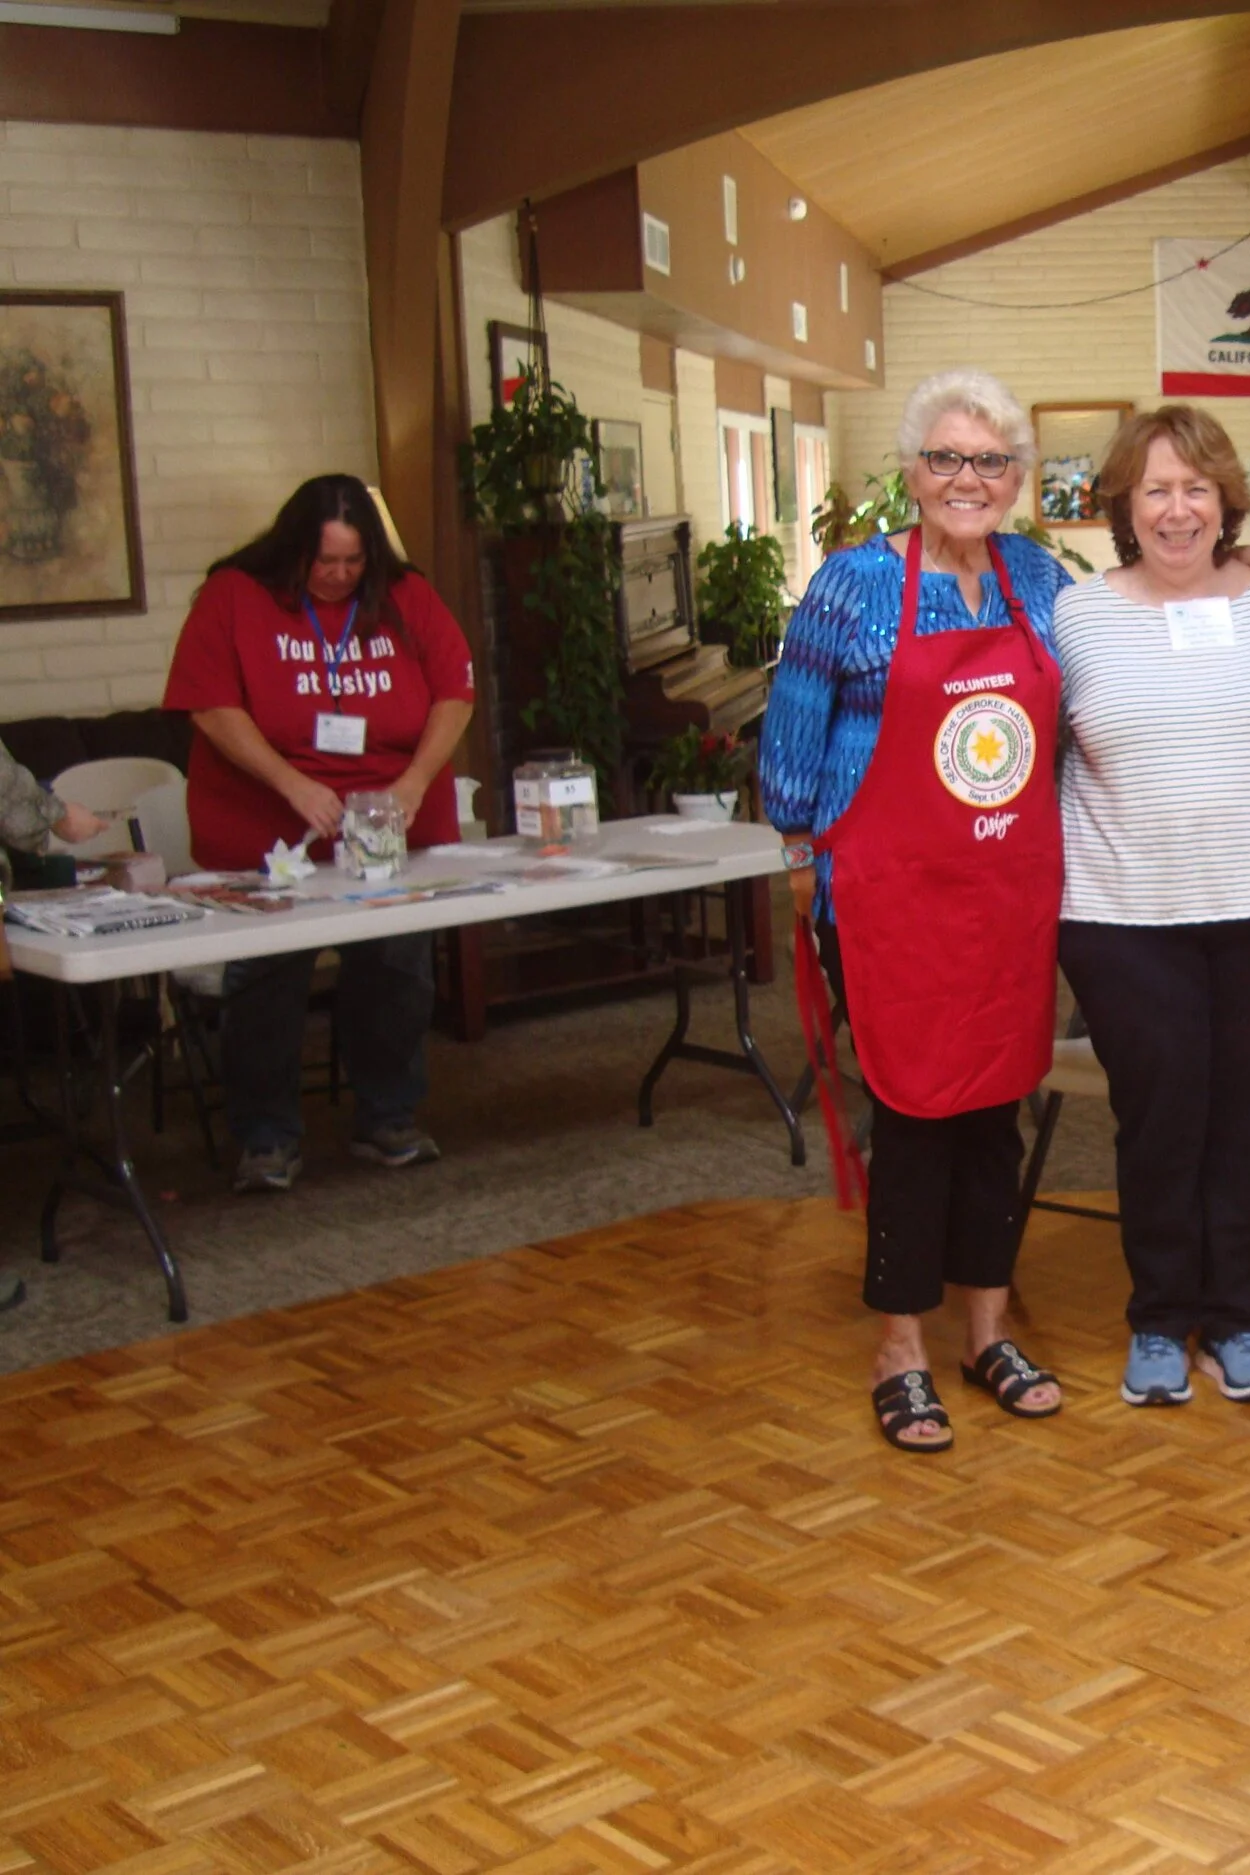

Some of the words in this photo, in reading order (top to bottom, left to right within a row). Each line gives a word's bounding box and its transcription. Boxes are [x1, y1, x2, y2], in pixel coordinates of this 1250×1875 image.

[277, 634, 315, 661] You
[297, 671, 321, 694] at
[943, 673, 1015, 695] VOLUNTEER
[956, 699, 1008, 718] CHEROKEE
[944, 719, 957, 740] THE
[1007, 707, 1030, 739] NATION
[940, 741, 949, 756] OF
[940, 757, 957, 784] SEAL
[974, 810, 1020, 840] Osiyo
